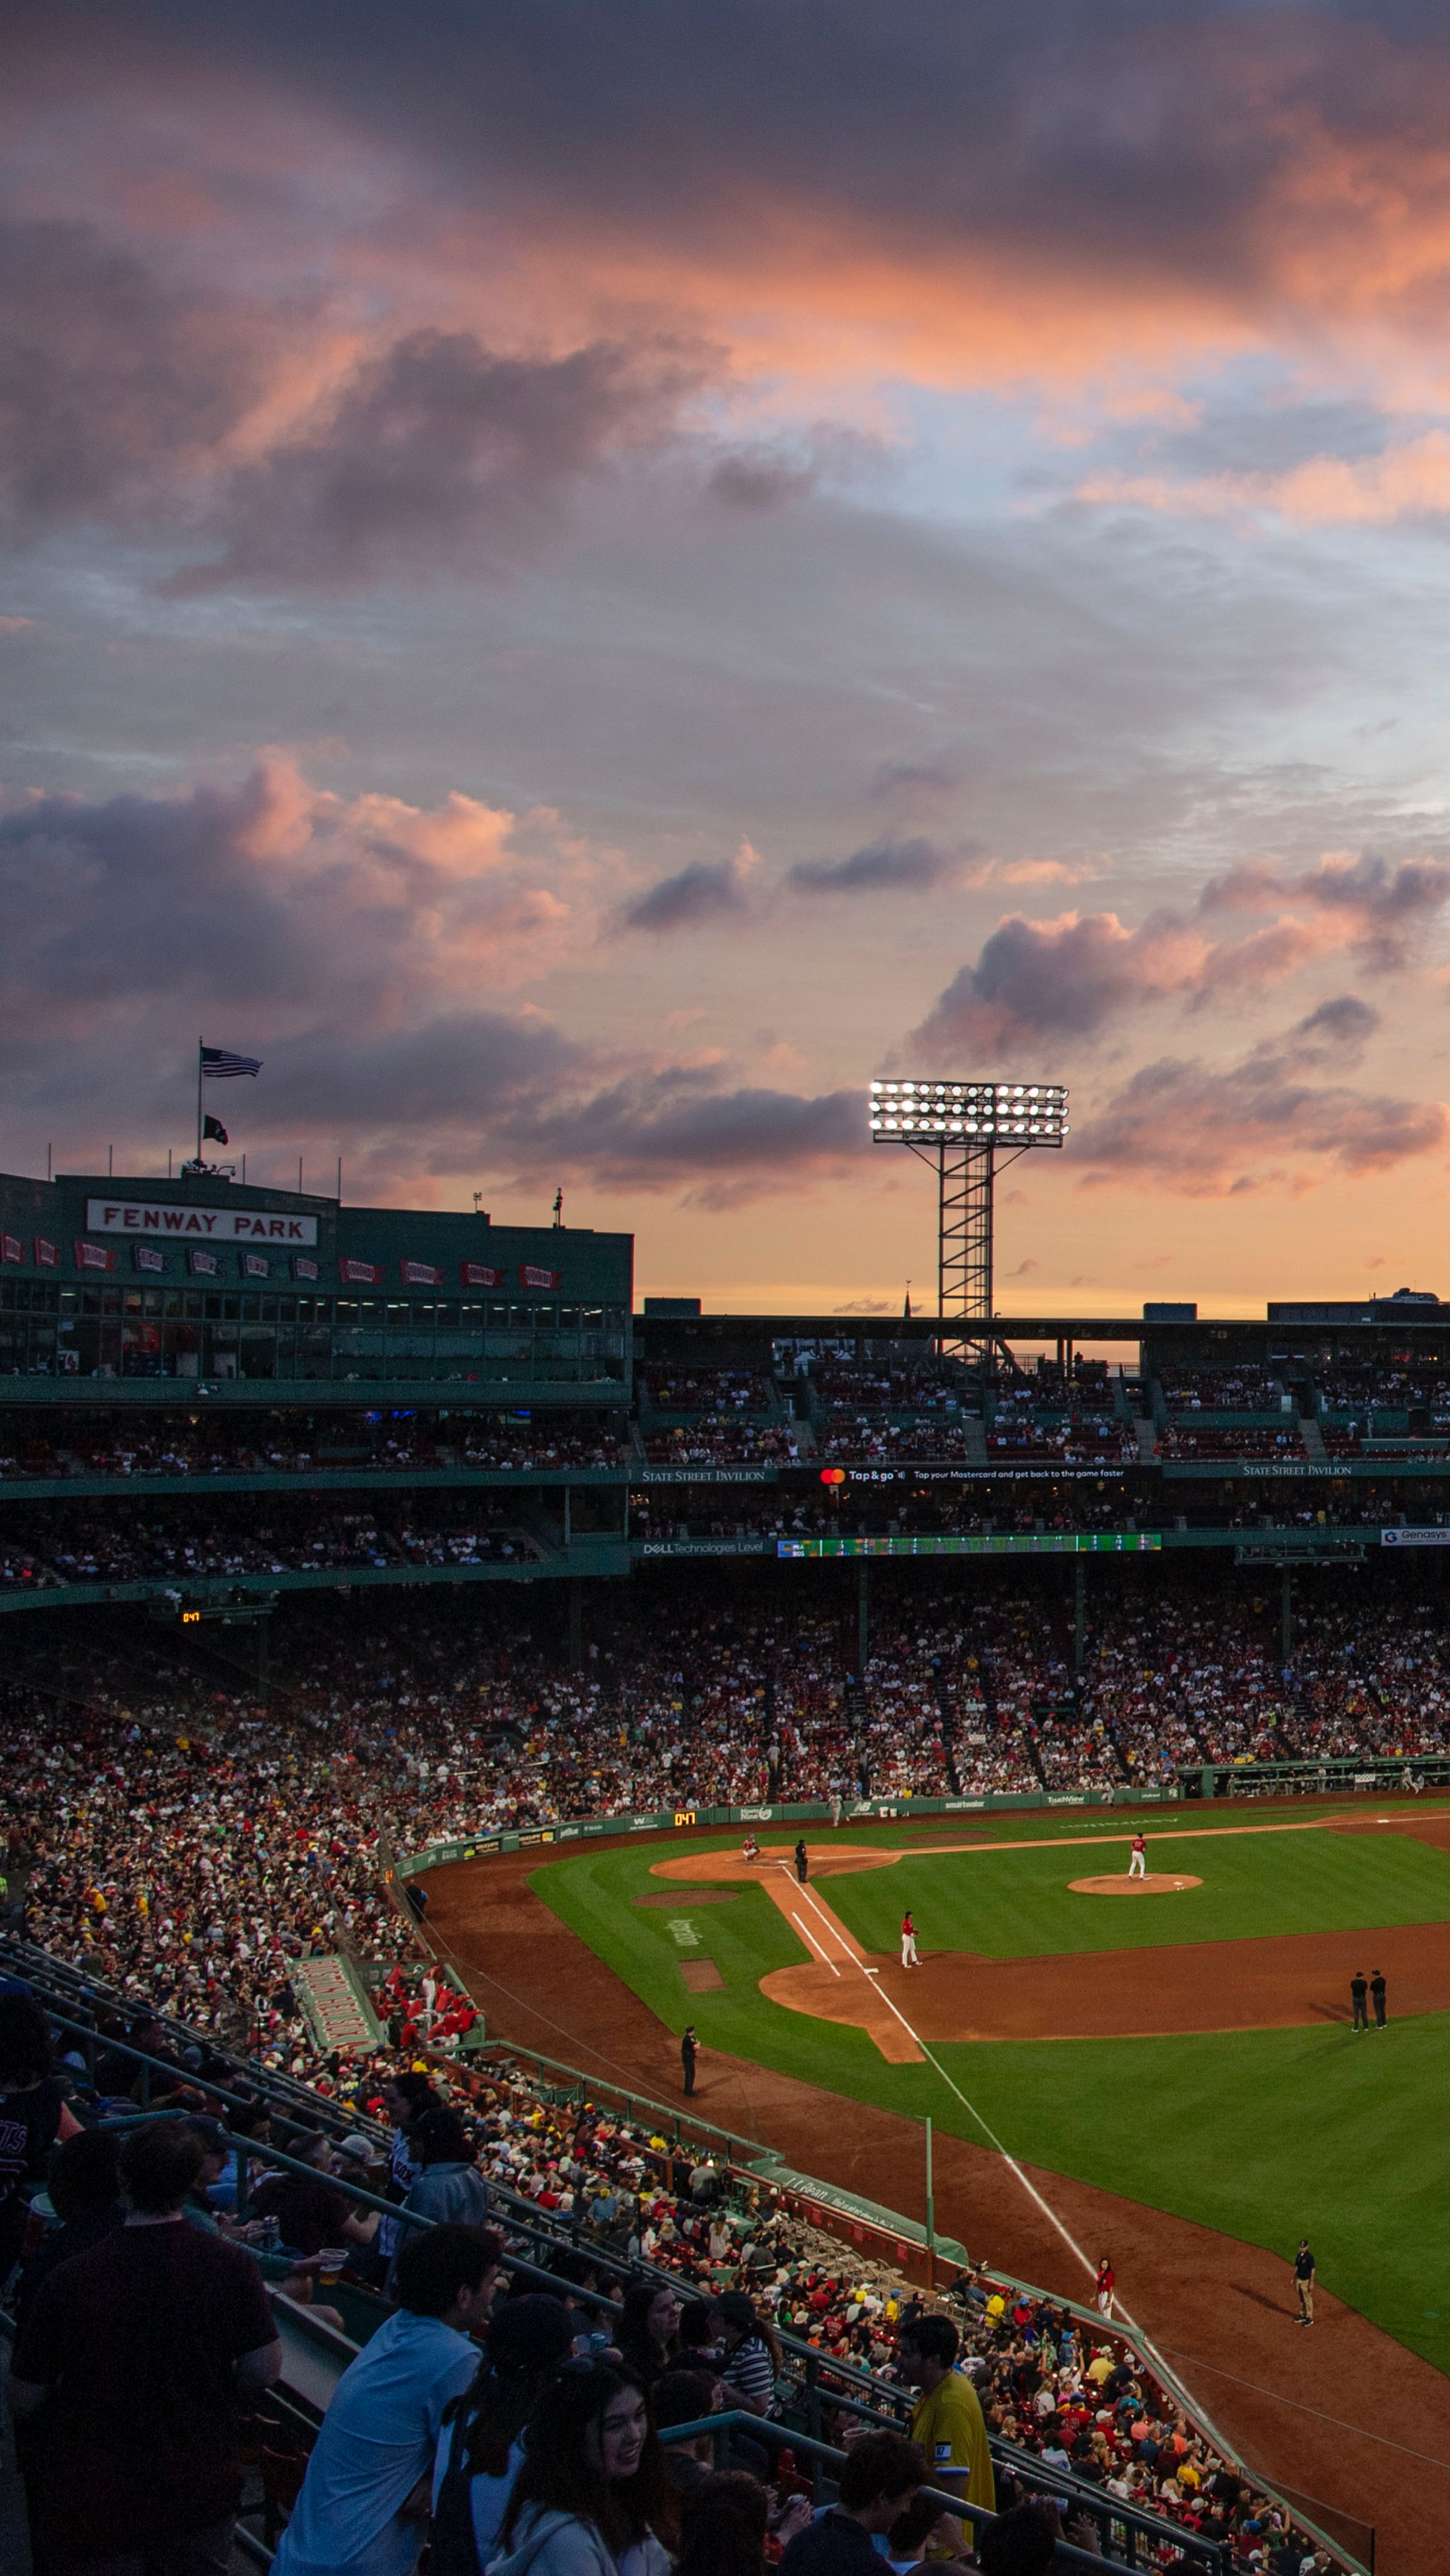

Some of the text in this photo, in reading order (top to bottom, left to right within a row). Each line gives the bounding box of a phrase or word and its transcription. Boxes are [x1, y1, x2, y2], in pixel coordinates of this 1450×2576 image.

[104, 1206, 304, 1239] FENWAY PARK
[914, 1471, 929, 1479] Tap
[931, 1472, 948, 1480] your
[1244, 1465, 1352, 1475] STATE STREET PAVILION
[643, 1471, 765, 1482] STATE STREET PAVILION
[1402, 1531, 1447, 1539] Genasys
[674, 1543, 736, 1555] Technologies
[738, 1542, 763, 1552] Level
[315, 1995, 361, 2018] RED
[323, 2016, 370, 2041] SOX
